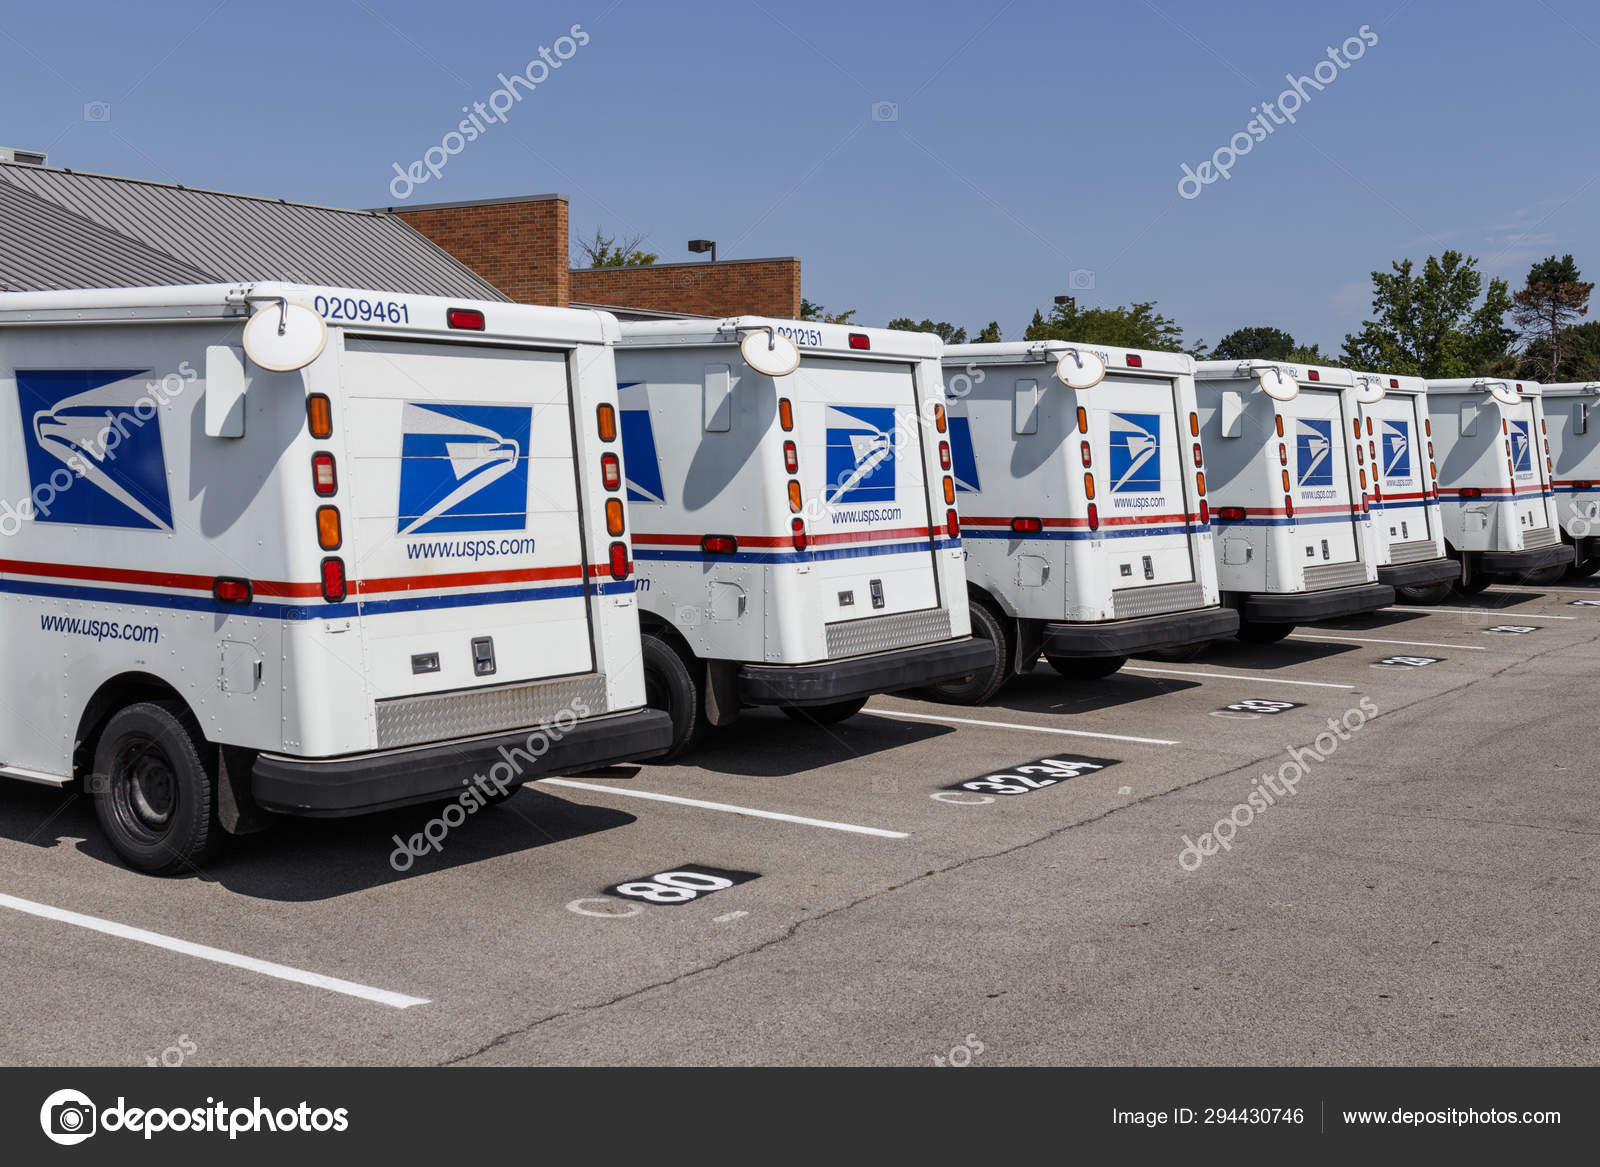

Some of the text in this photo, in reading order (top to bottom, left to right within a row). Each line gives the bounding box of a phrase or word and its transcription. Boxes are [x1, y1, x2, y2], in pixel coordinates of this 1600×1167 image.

[314, 295, 409, 324] 0209461
[831, 507, 902, 525] www.usps.com
[1113, 497, 1166, 510] www.usps.com
[406, 538, 536, 561] www.usps.com
[40, 614, 159, 643] www.usps.com
[1227, 700, 1295, 713] 33
[962, 759, 1104, 795] 3234
[616, 871, 734, 902] 80
